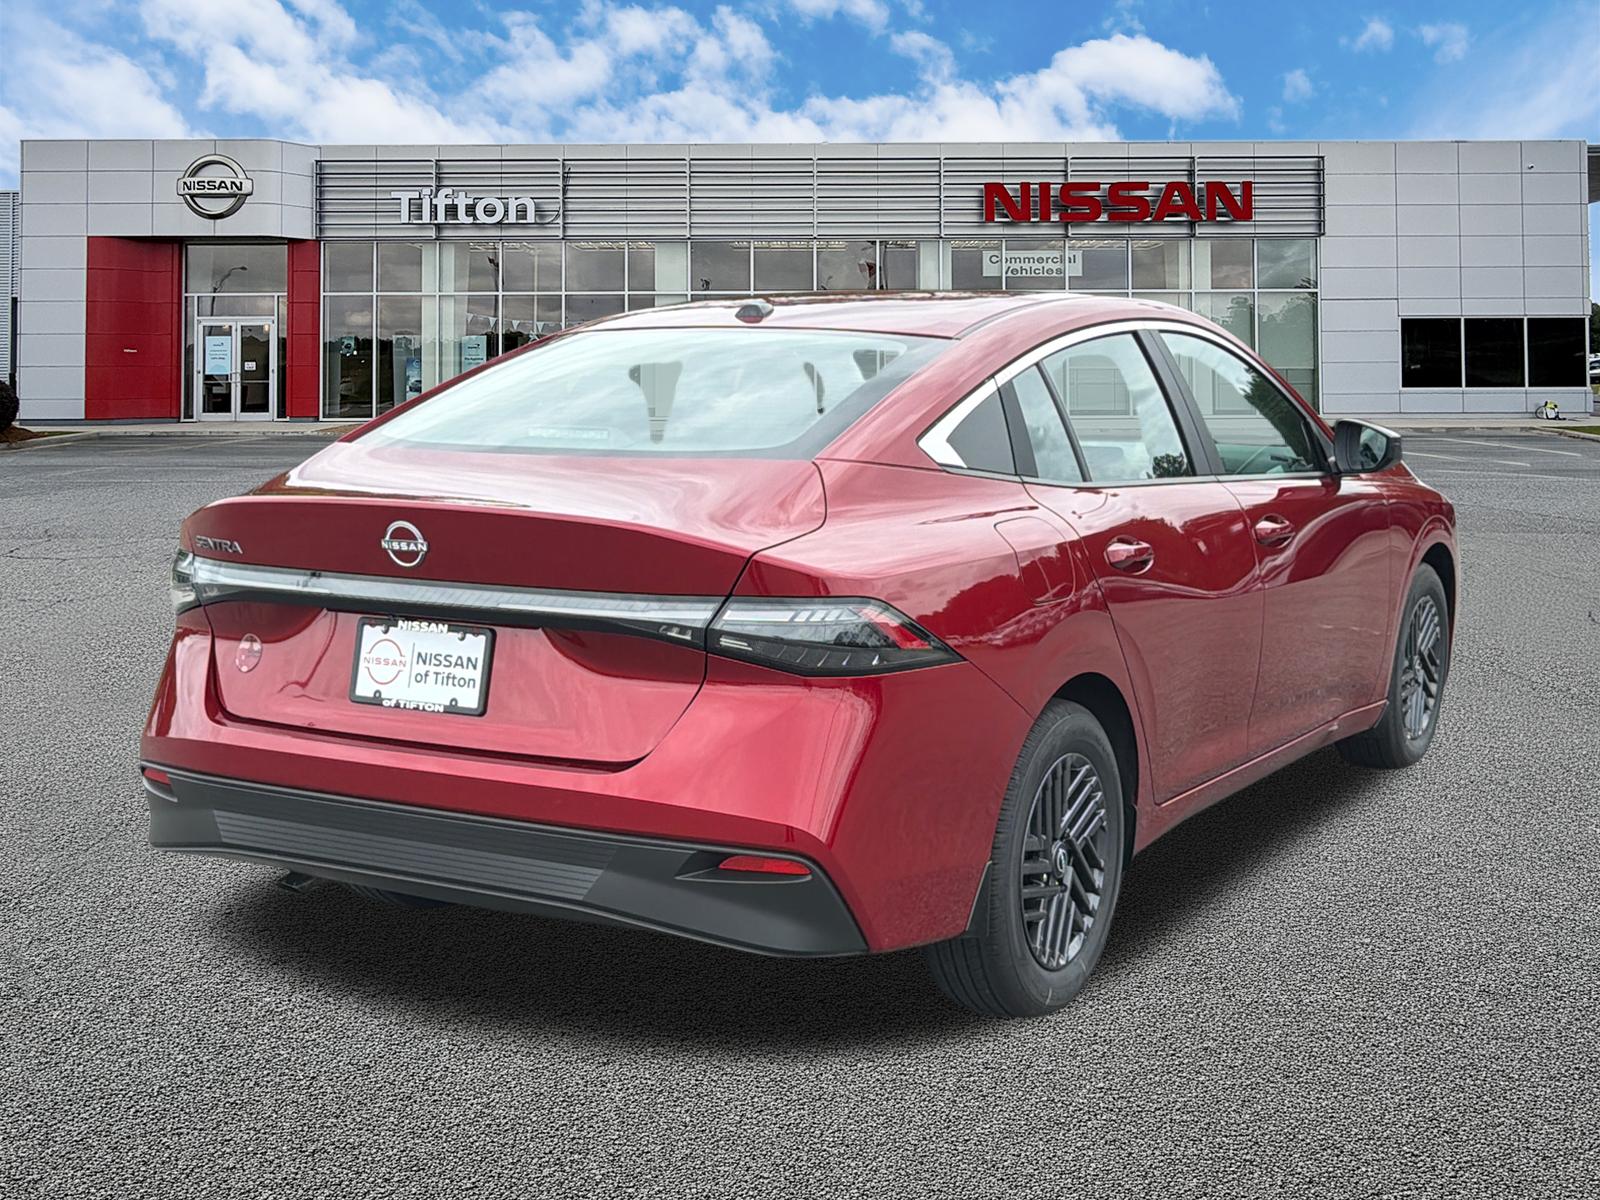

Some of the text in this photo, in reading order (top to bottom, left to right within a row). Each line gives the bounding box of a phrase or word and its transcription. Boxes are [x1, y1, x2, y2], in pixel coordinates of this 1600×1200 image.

[183, 180, 243, 191] NISSAN
[391, 188, 535, 224] Tifton
[983, 181, 1253, 223] NISSAN
[381, 539, 428, 552] NISSAN
[398, 620, 448, 634] NISSAN
[363, 656, 407, 667] NISSAN
[416, 651, 478, 671] NISSAN
[414, 670, 476, 689] of Tifton
[382, 699, 445, 713] of TIFTON
